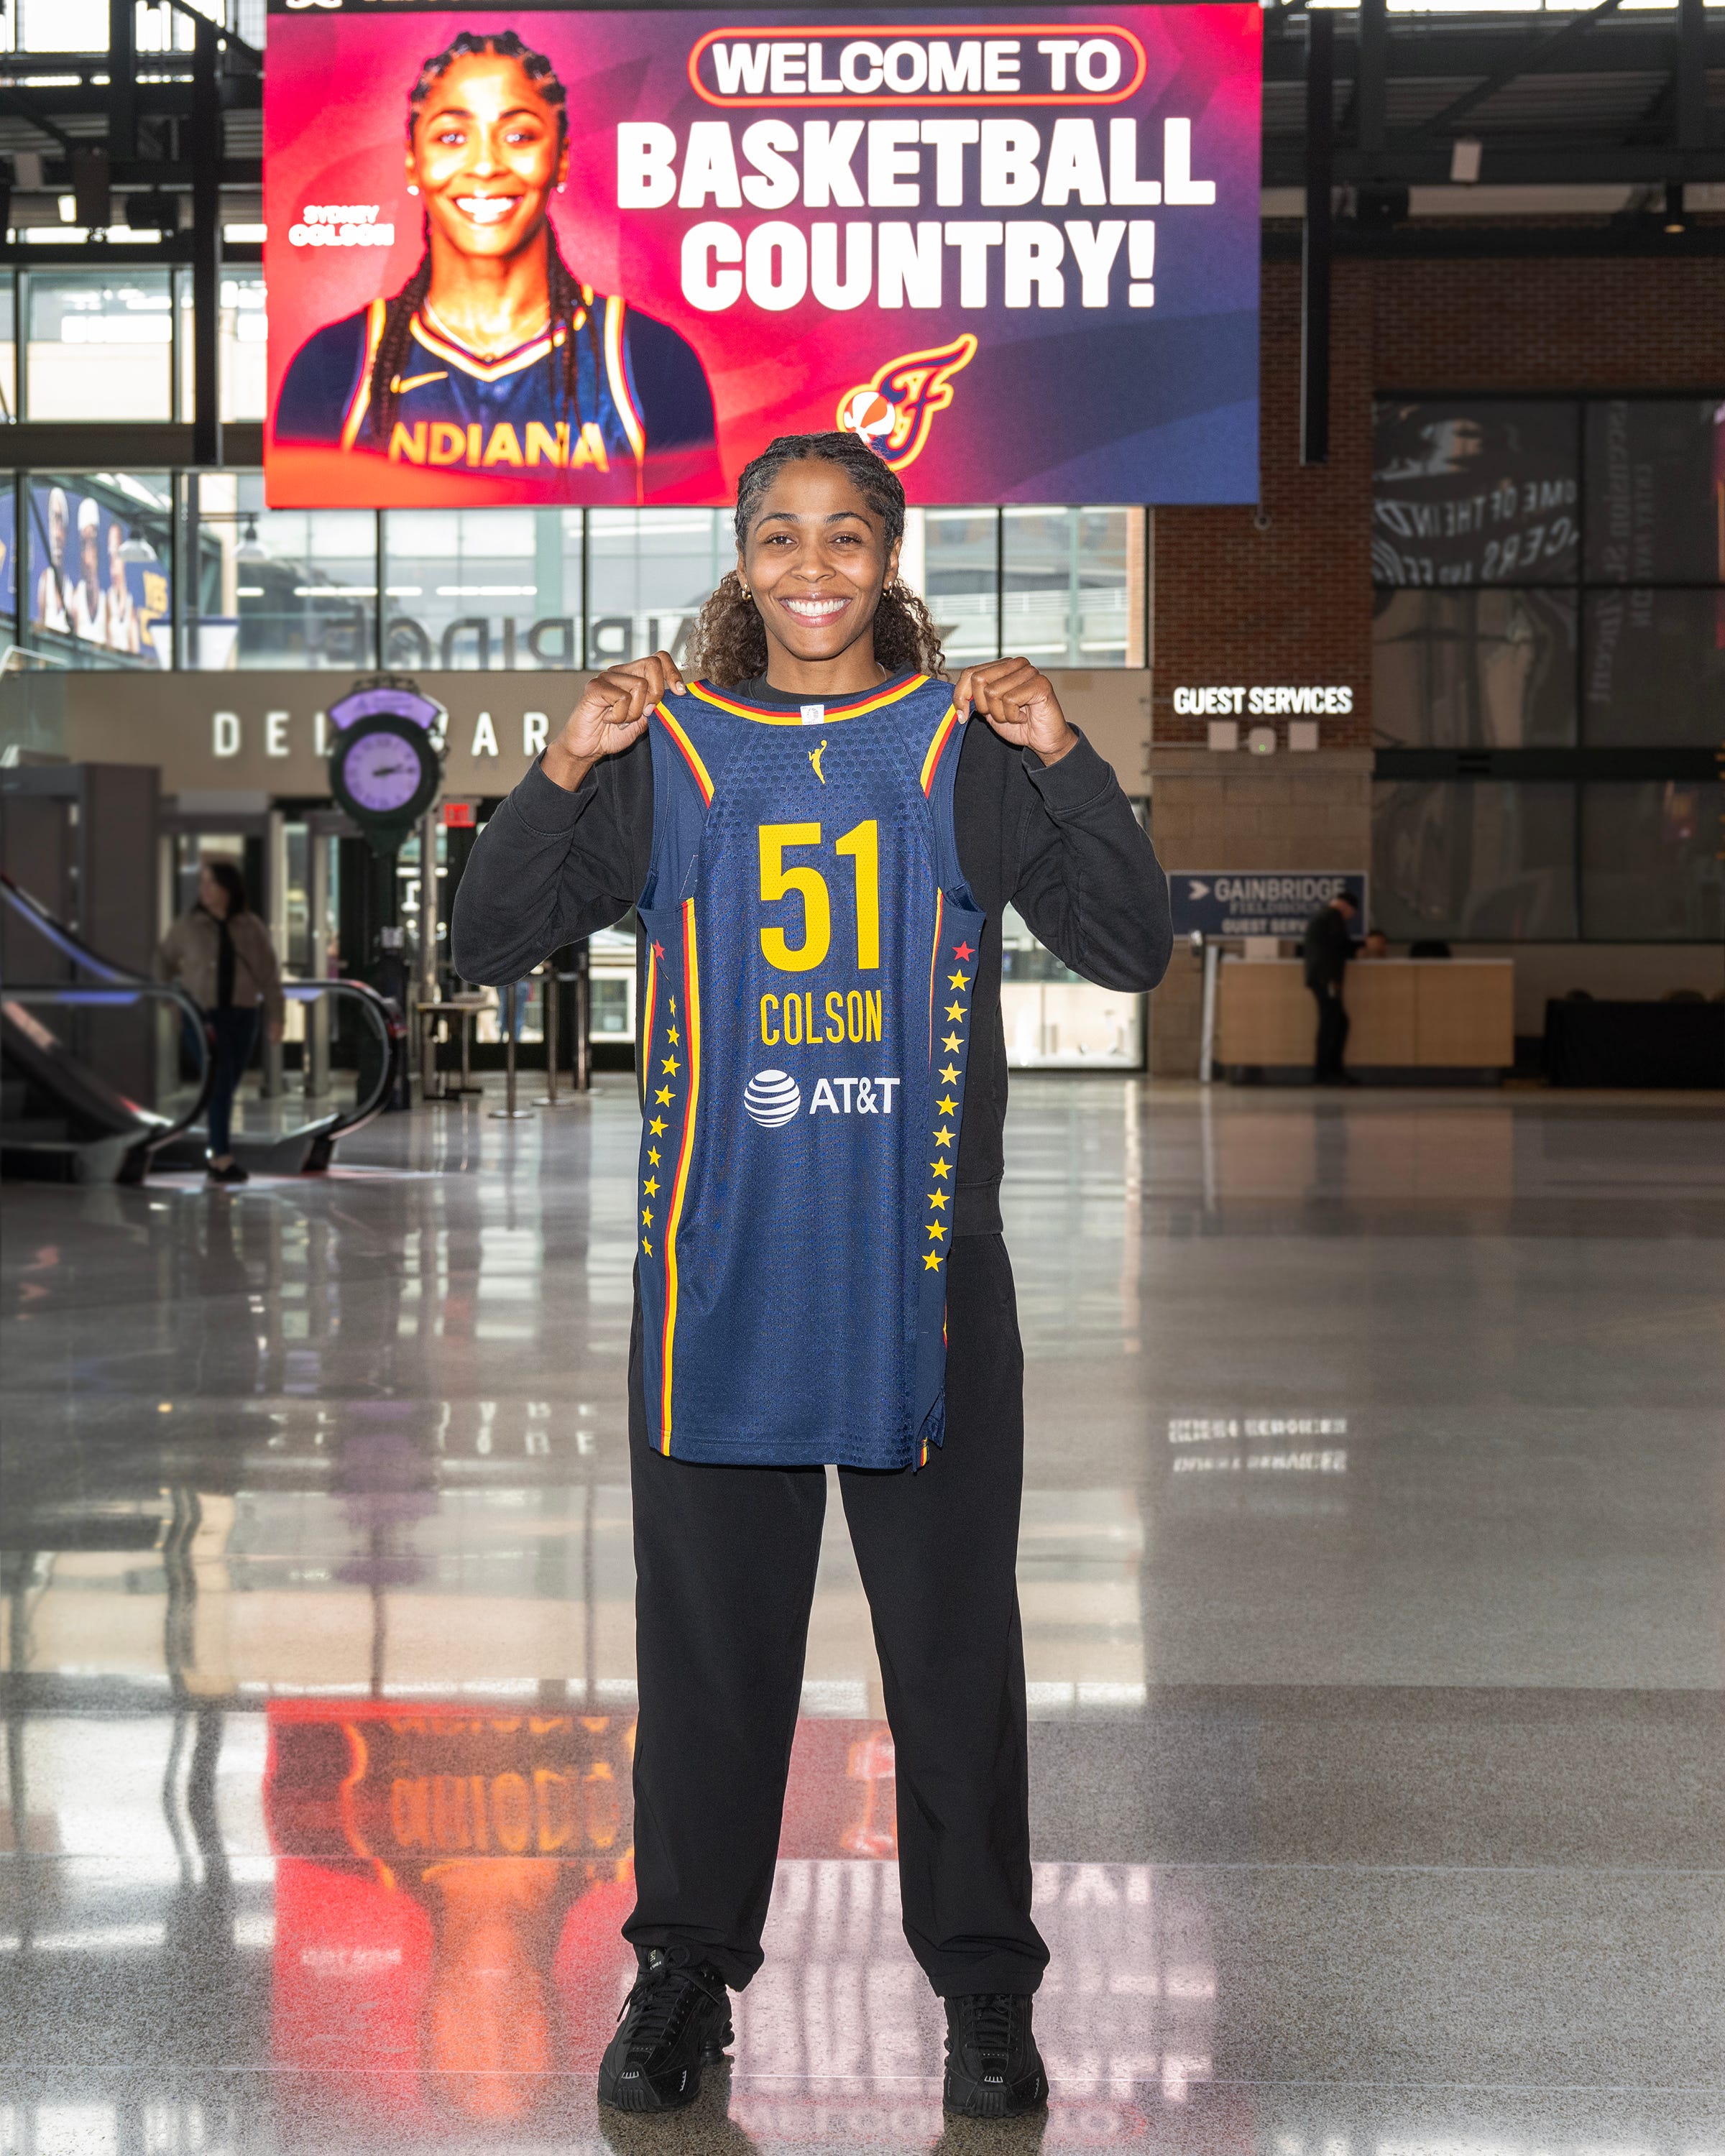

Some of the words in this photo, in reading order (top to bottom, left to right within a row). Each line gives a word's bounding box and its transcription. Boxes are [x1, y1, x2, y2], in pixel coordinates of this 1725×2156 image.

[712, 40, 1021, 94] WELCOME
[1038, 39, 1121, 93] TO
[617, 117, 1217, 209] BASKETBALL
[680, 220, 1156, 311] COUNTRY!
[388, 421, 610, 473] NDIANA
[1174, 686, 1247, 715] GUEST
[1248, 685, 1353, 715] SERVICES
[758, 819, 880, 972] 51
[1213, 877, 1346, 902] GAINBRIDGE
[759, 989, 883, 1047] COLSON
[809, 1077, 901, 1116] AT&T
